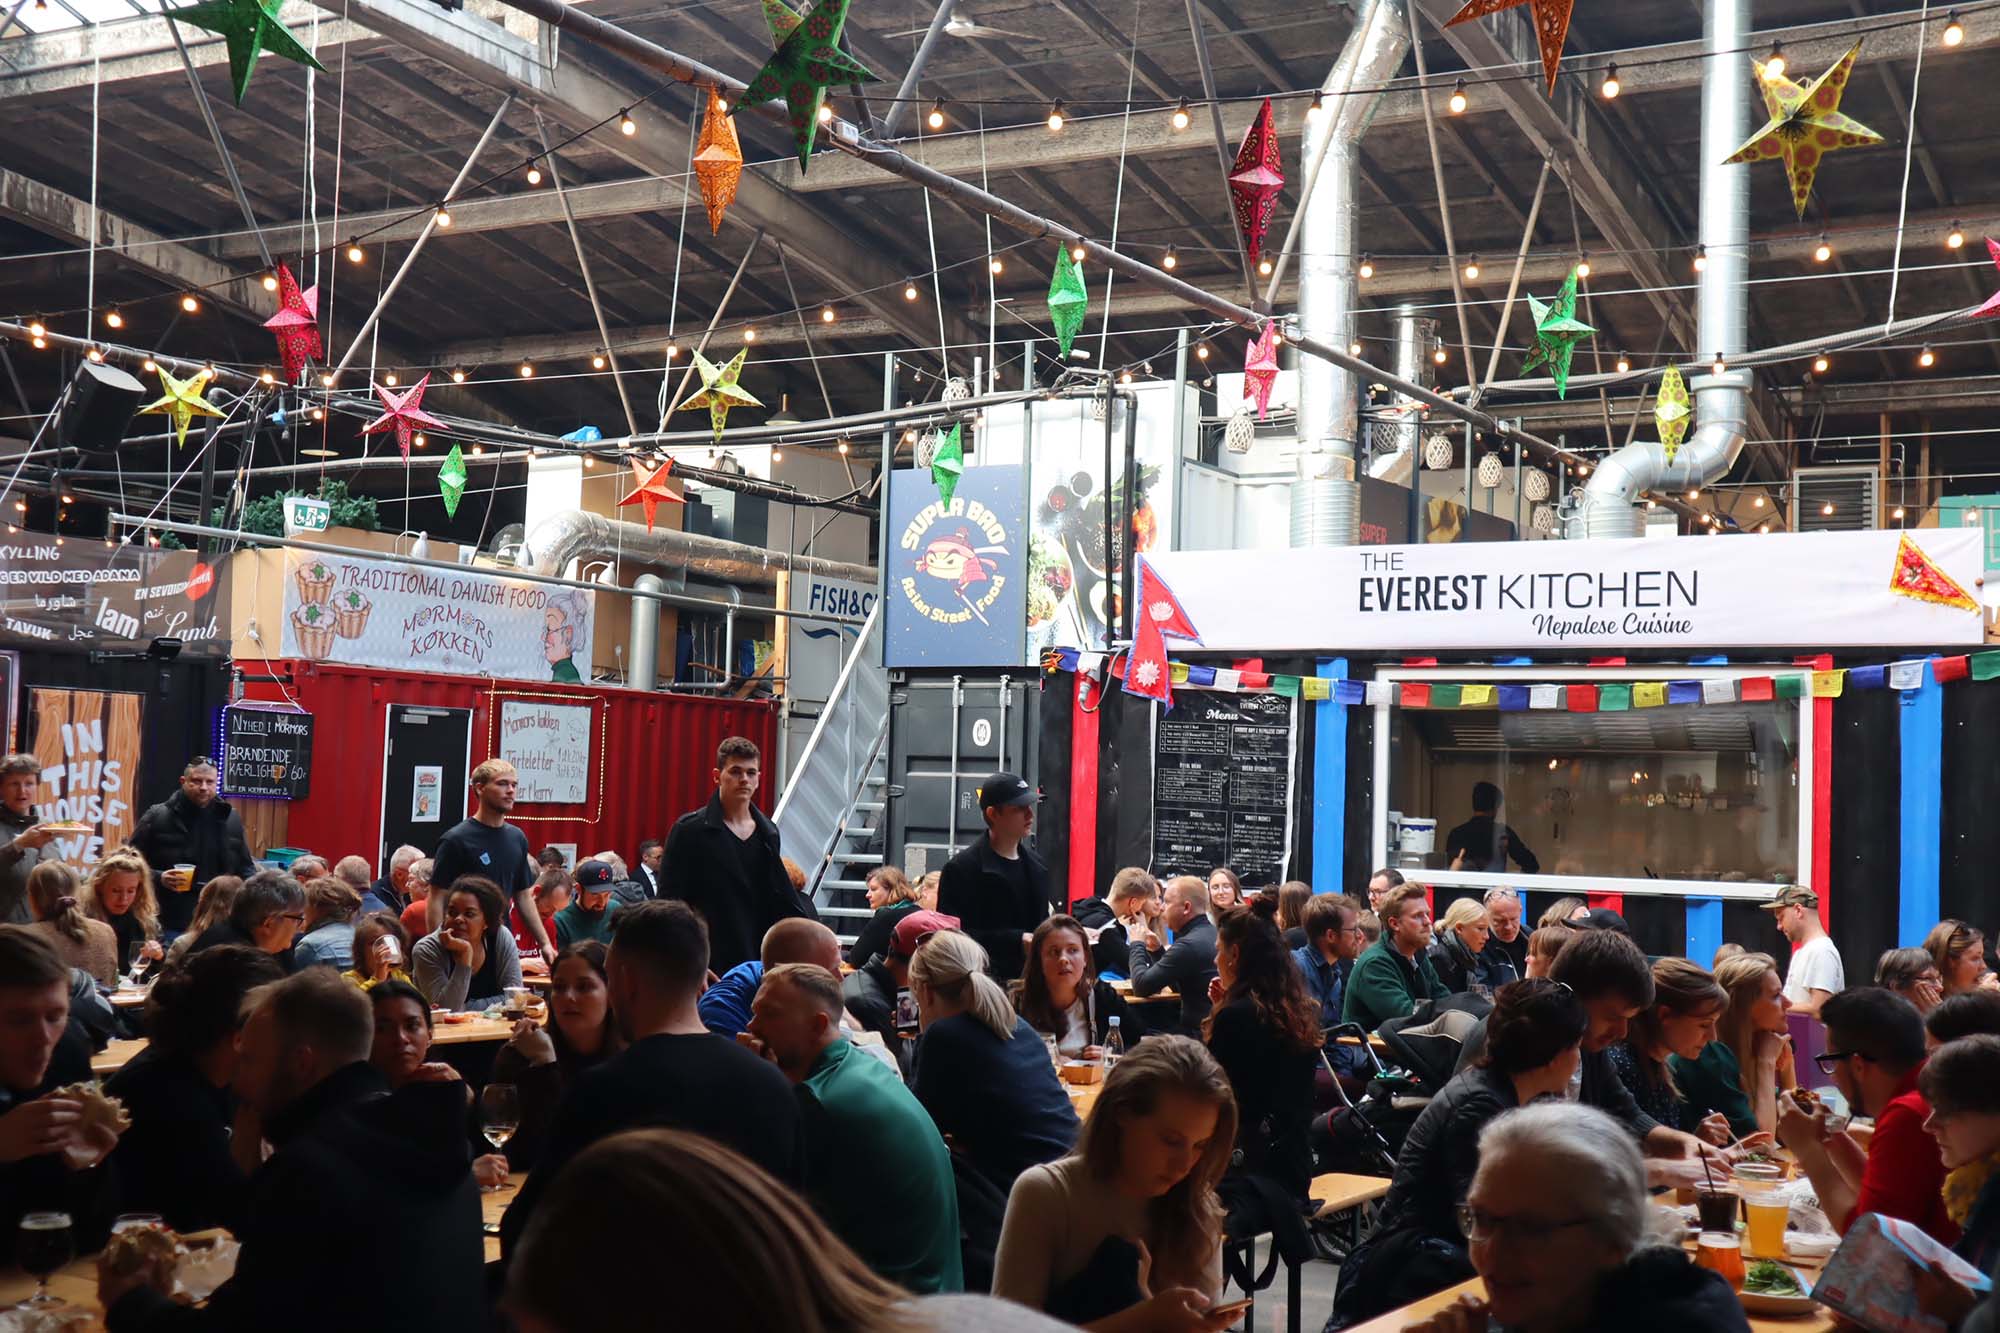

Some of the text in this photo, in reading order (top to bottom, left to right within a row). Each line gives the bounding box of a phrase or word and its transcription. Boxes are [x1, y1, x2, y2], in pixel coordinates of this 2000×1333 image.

[1359, 522, 1388, 545] SUPER
[0, 545, 60, 561] KYLLING
[1360, 552, 1404, 571] THE
[9, 570, 27, 584] ER
[28, 570, 62, 584] VILD
[62, 569, 92, 584] MED
[93, 569, 141, 582] ADANA
[341, 564, 547, 611] TRADITIONAL DANISH FOOD
[1359, 570, 1698, 612] EVEREST KITCHEN
[810, 584, 878, 618] FISH&C
[901, 575, 1006, 623] Asian Street Food
[6, 617, 53, 641] TAVUK
[96, 597, 140, 639] lam
[165, 611, 219, 642] Lamb
[402, 604, 494, 648] MORMORS
[1532, 612, 1693, 640] Nepalese Cuisine
[410, 630, 484, 665] KØKKEN
[275, 722, 309, 736] MORMORS
[1205, 709, 1239, 721] Menu
[62, 719, 103, 758] IN
[41, 760, 123, 797] THIS
[229, 762, 286, 779] KÆRLIGHED
[35, 795, 128, 827] HOUSE
[55, 834, 104, 865] WE
